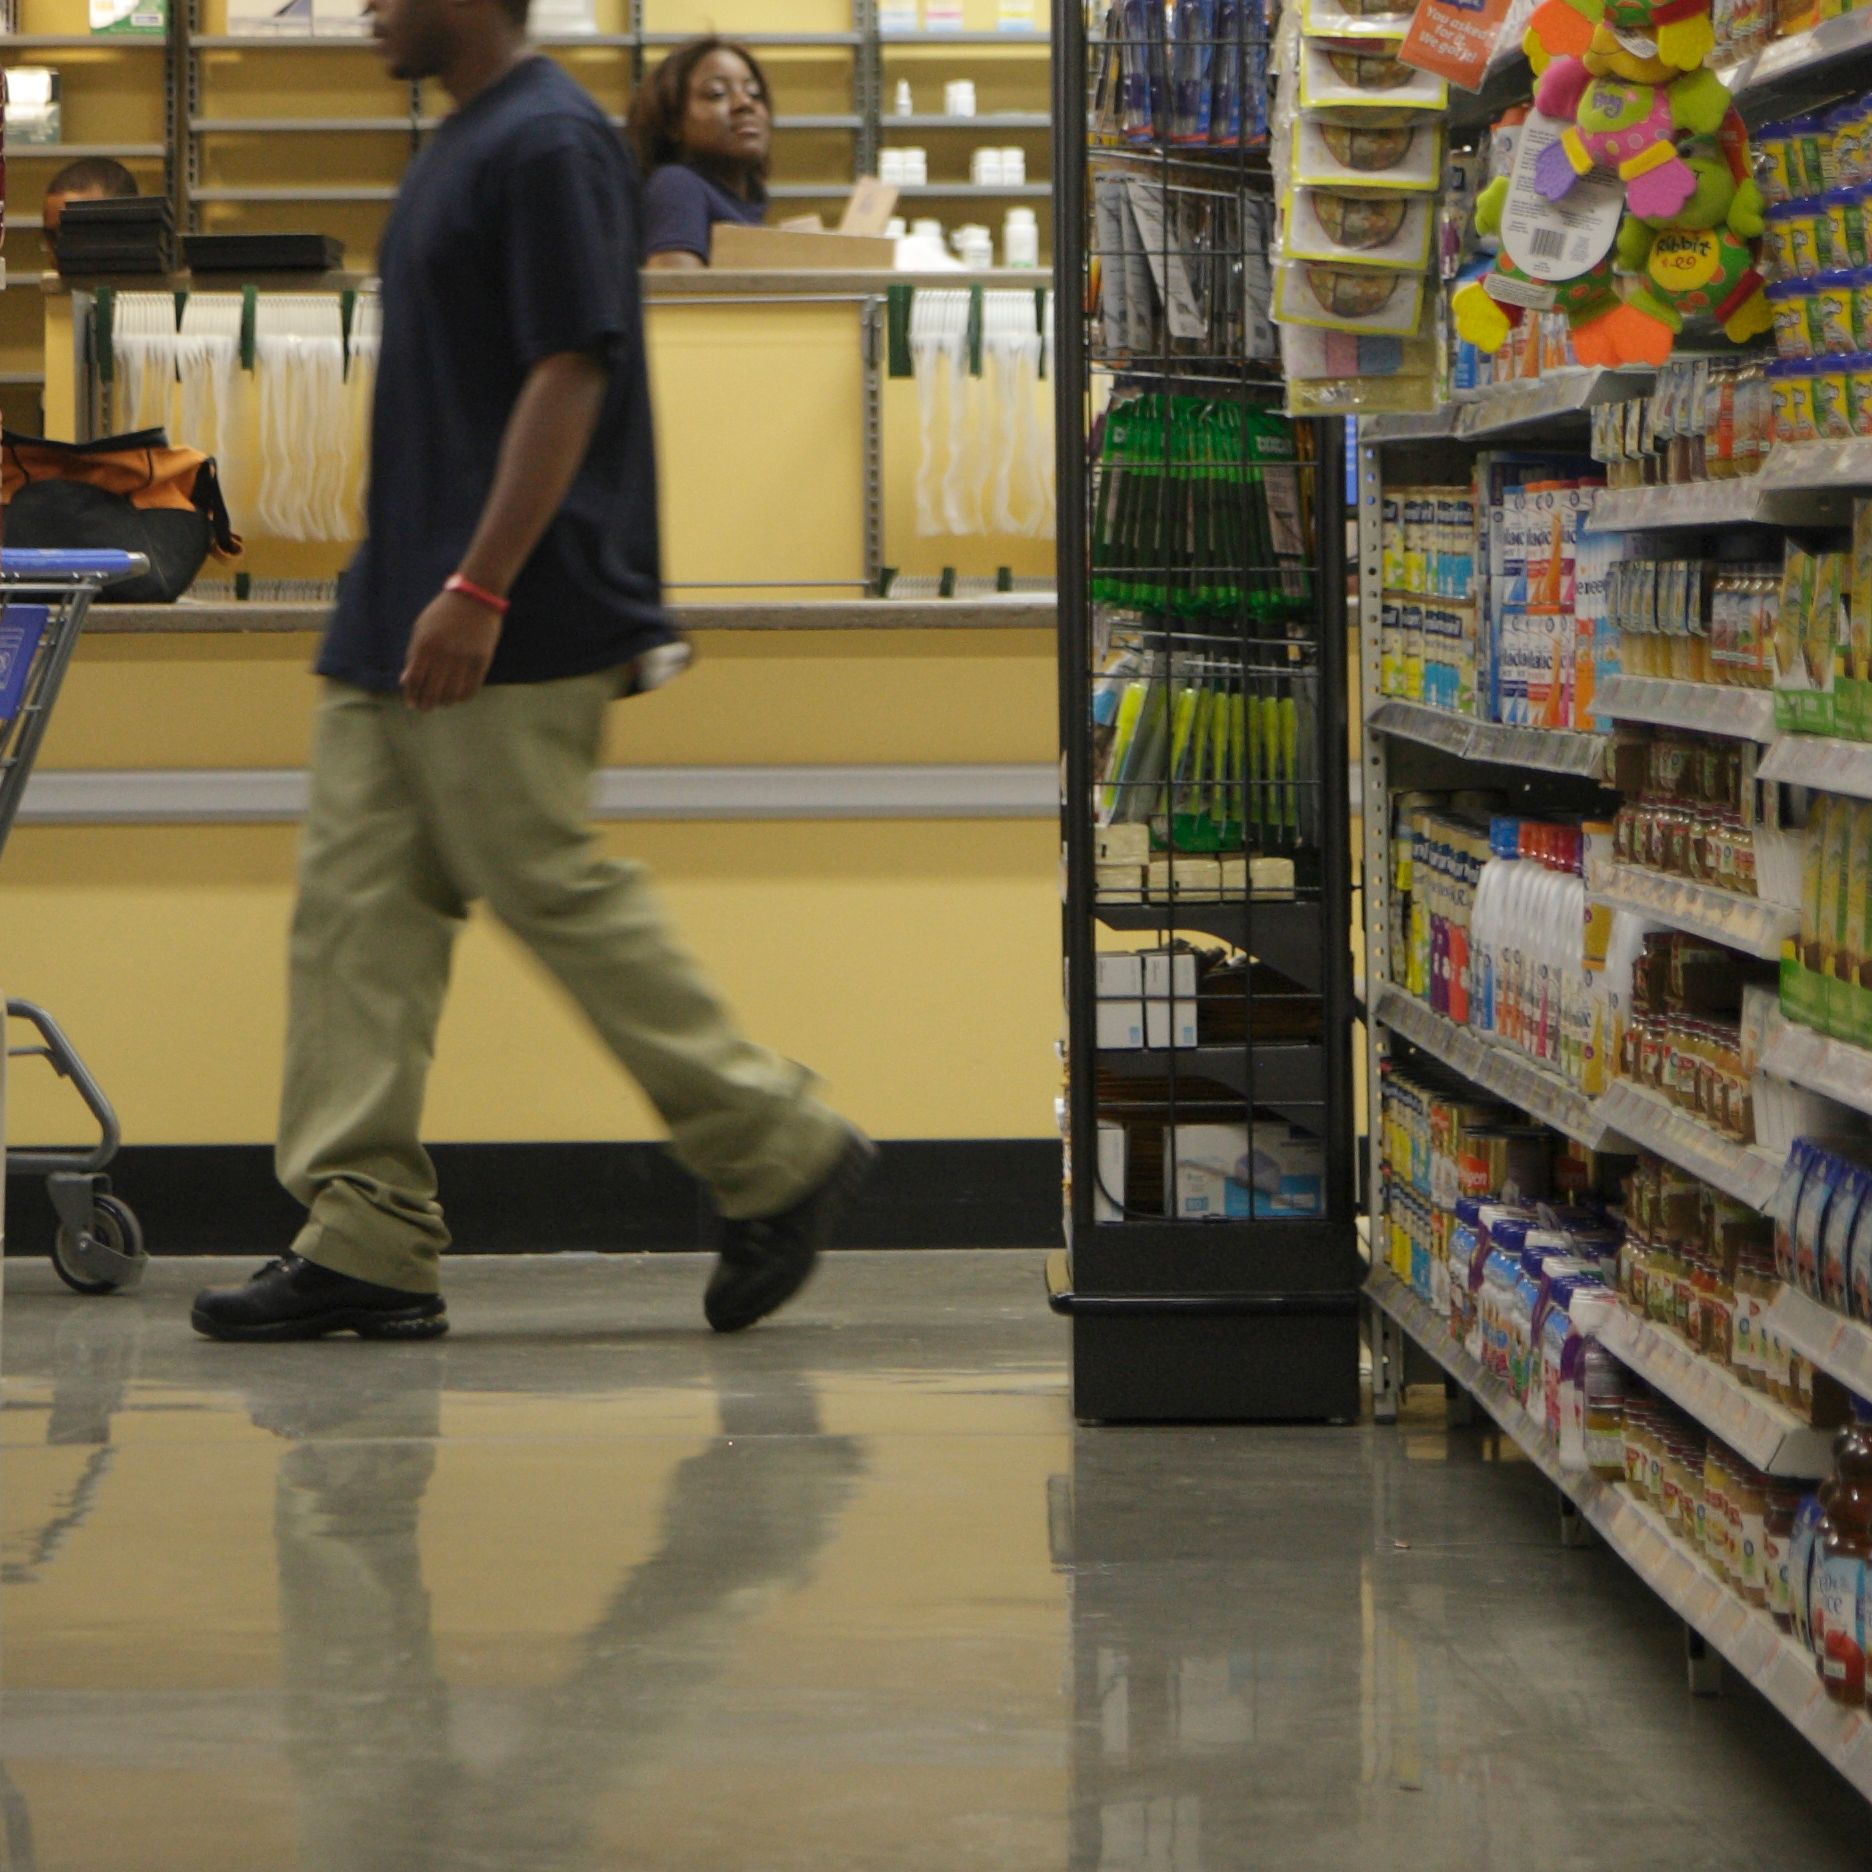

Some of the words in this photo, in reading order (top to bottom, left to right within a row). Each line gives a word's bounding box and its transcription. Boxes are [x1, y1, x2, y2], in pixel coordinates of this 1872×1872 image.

[1425, 6, 1447, 25] You
[1419, 30, 1435, 48] We
[1434, 23, 1452, 40] for
